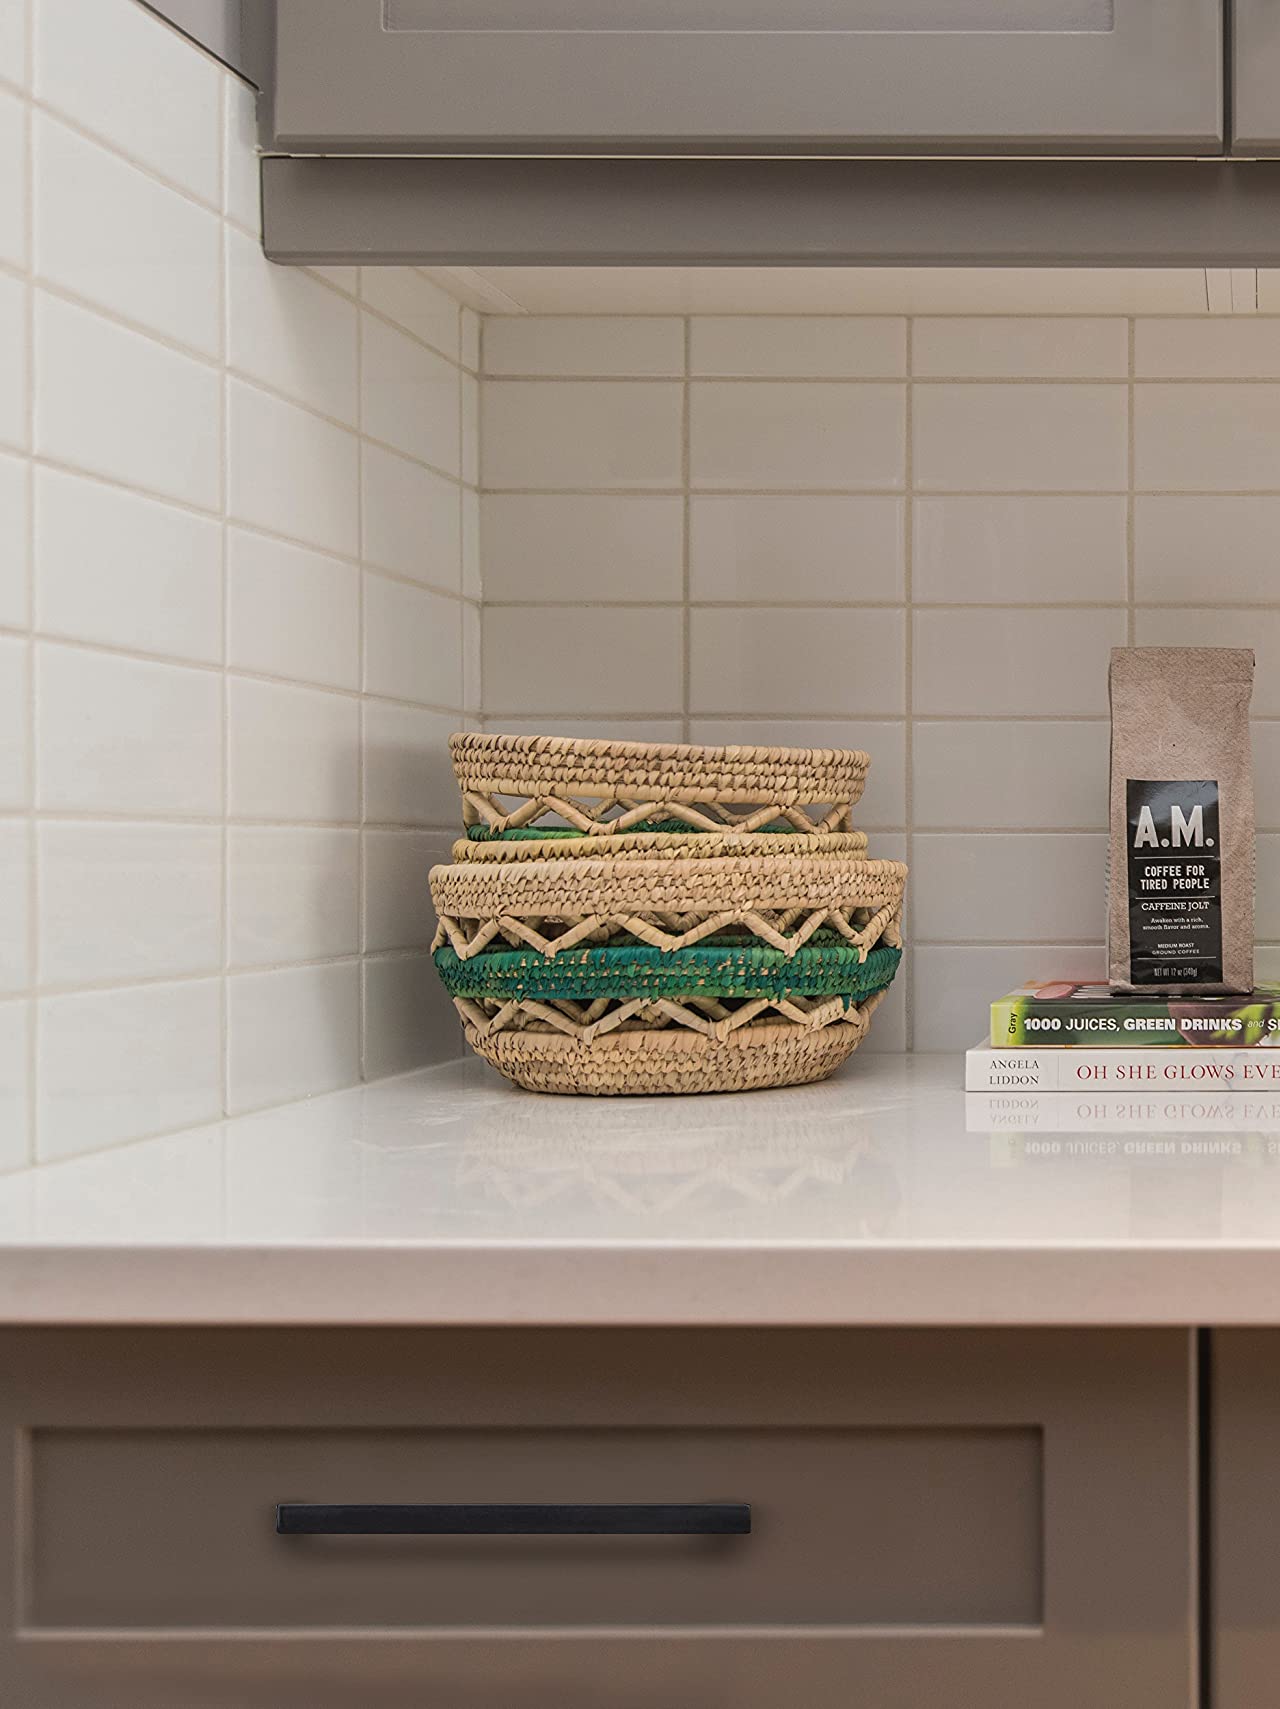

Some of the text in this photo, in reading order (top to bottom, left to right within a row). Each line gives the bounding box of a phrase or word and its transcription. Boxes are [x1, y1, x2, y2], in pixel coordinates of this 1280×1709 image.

[1134, 805, 1215, 848] A.M.
[1144, 865, 1205, 876] COFFEE FOR
[1140, 878, 1210, 890] TIRED PEOPLE
[1142, 902, 1210, 912] CAFFEINE JOLT
[1154, 968, 1162, 976] NET
[1008, 1012, 1018, 1034] Gray
[1024, 1018, 1062, 1031] 1000
[1065, 1018, 1120, 1032] JUICES,
[1124, 1018, 1176, 1031] GREEN
[1181, 1018, 1242, 1031] DRINKS
[1248, 1019, 1264, 1028] and
[990, 1060, 1040, 1070] ANGELA
[1076, 1065, 1107, 1080] OH
[1116, 1064, 1157, 1080] SHE
[1164, 1064, 1234, 1080] GLOWS
[990, 1075, 1040, 1085] LIDDON
